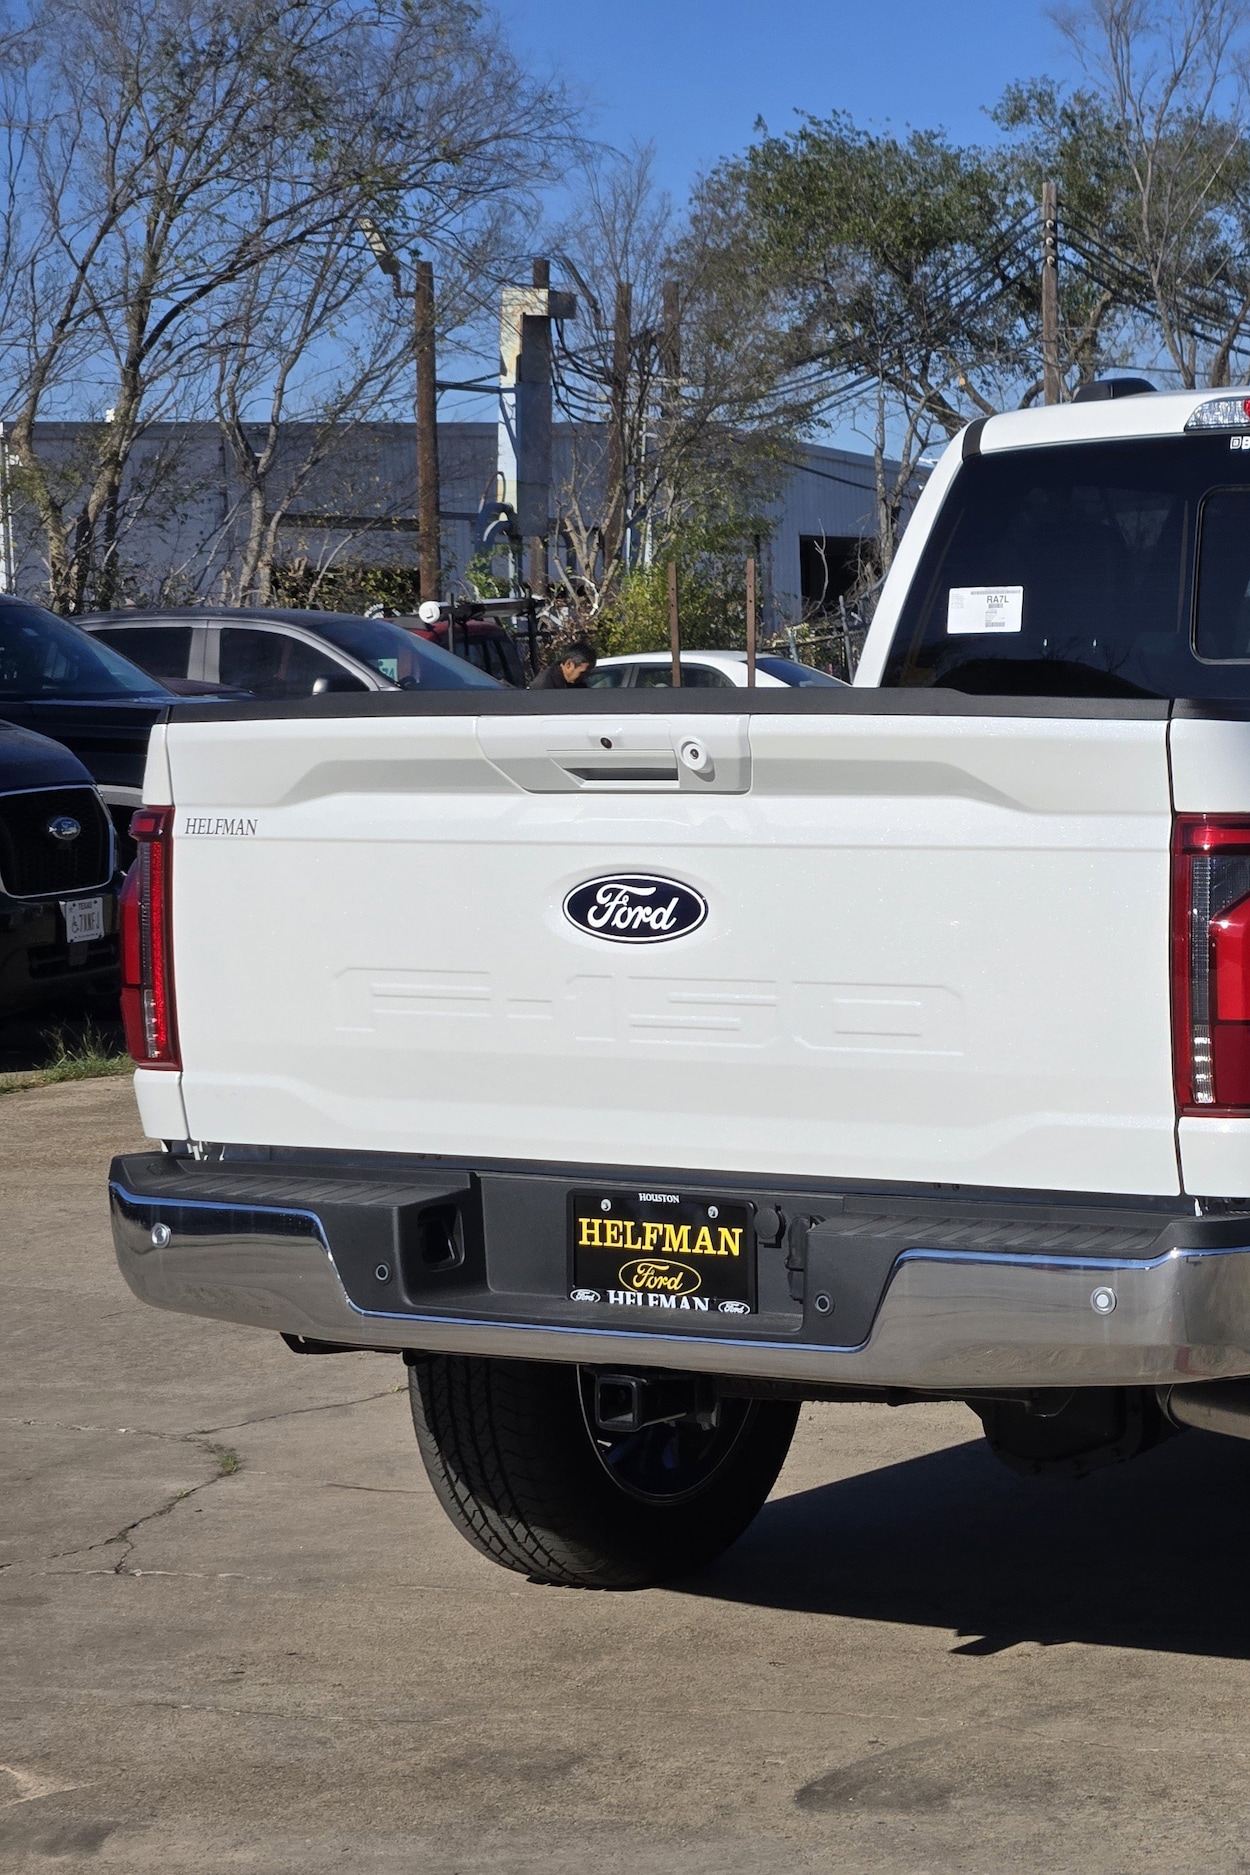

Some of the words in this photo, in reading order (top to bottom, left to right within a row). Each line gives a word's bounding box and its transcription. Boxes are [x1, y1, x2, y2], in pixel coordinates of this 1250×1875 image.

[986, 595, 1009, 604] RA7L
[184, 817, 259, 836] HELFMAN
[587, 883, 680, 931] Ford
[638, 1192, 681, 1204] HOUSTON
[578, 1217, 744, 1257] HELFMAN
[632, 1262, 685, 1291] Ford
[606, 1289, 711, 1312] HELFMAN
